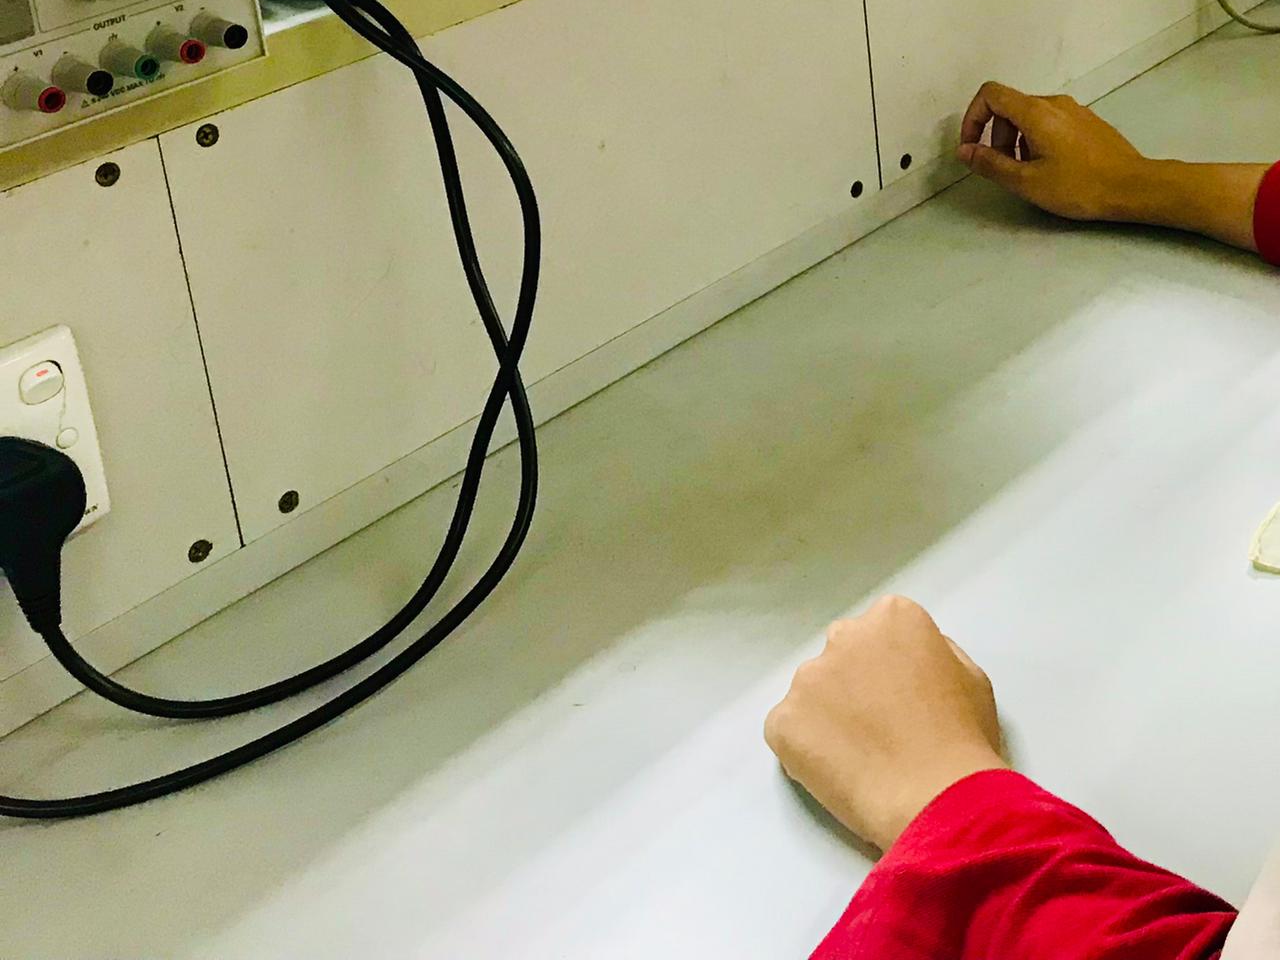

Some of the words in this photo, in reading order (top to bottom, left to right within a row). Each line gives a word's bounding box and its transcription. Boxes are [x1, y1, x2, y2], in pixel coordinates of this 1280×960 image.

[174, 4, 184, 12] V2
[93, 14, 126, 31] OUTPUT
[33, 49, 43, 57] V1
